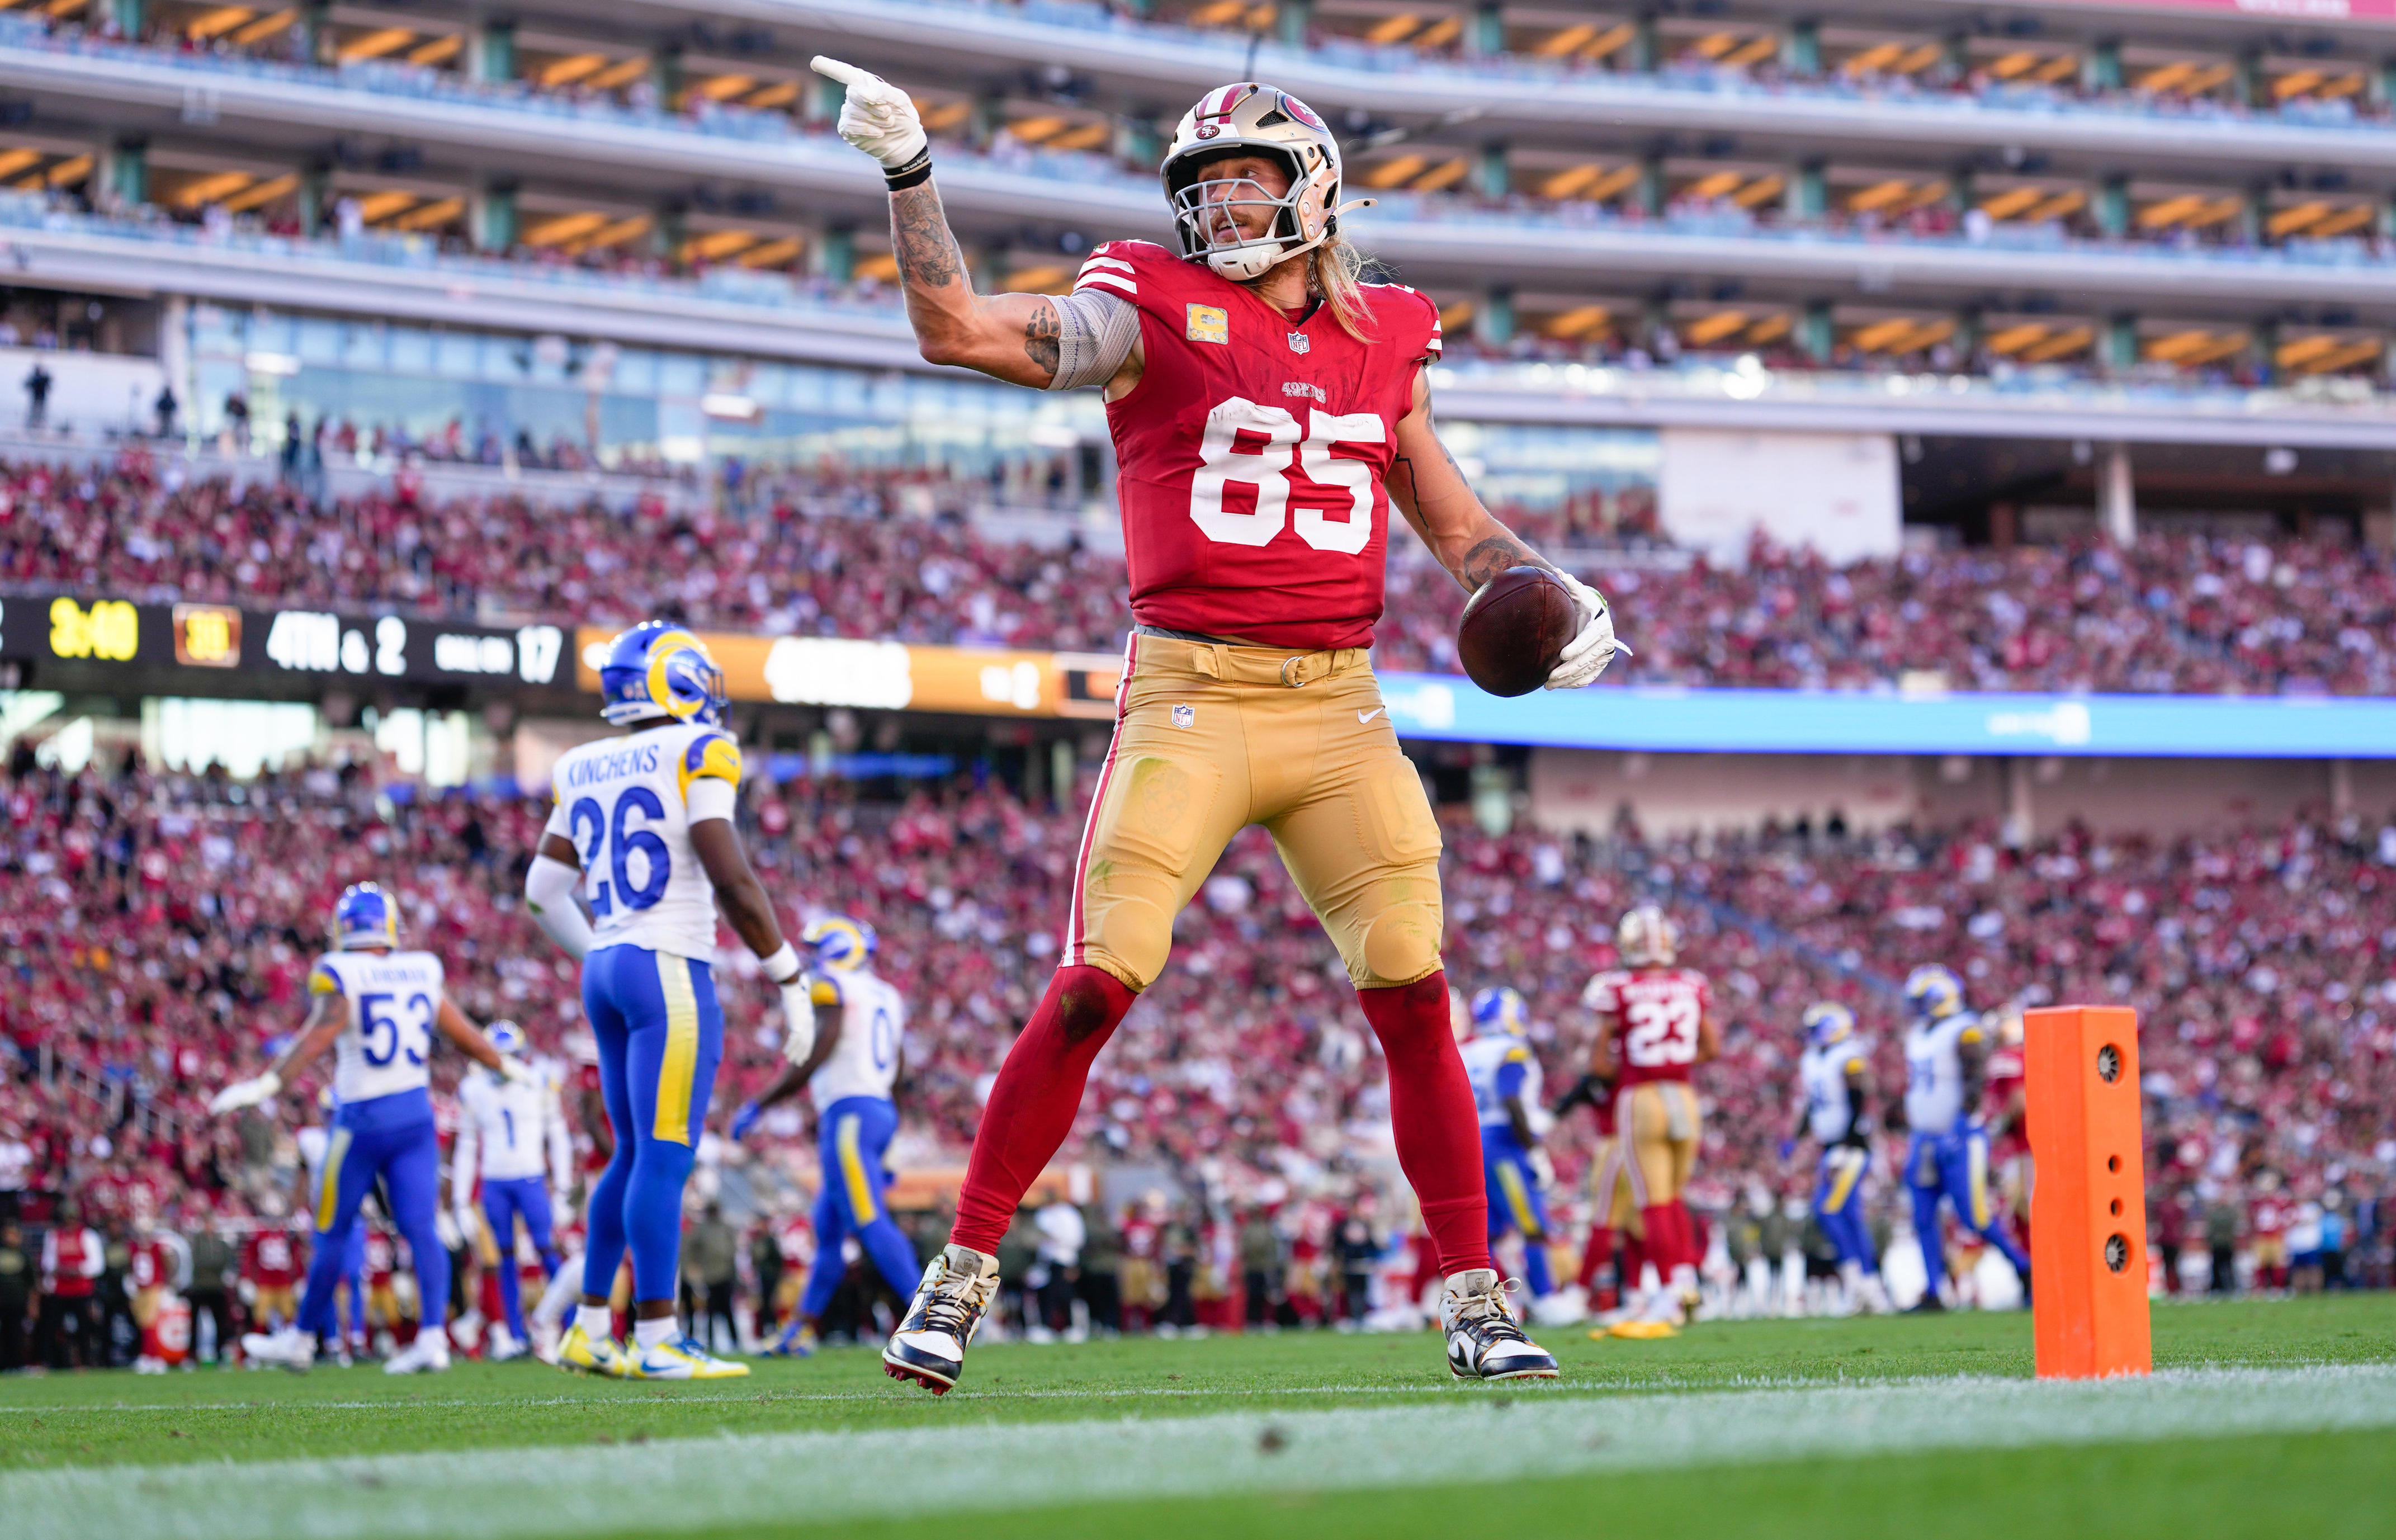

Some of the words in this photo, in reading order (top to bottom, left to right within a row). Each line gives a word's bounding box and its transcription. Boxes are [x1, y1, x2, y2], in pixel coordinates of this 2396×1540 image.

[1190, 306, 1226, 334] C
[1293, 341, 1306, 350] NFL
[1281, 381, 1327, 404] 49ERS
[1189, 396, 1386, 555] 85
[266, 610, 339, 671] 4TH
[376, 616, 407, 675] 2
[517, 625, 563, 684] 17
[1175, 714, 1190, 724] NFL
[568, 744, 659, 787] KINCHENS
[569, 786, 670, 916] 26
[358, 992, 432, 1069] 53
[1627, 1002, 1701, 1067] 23
